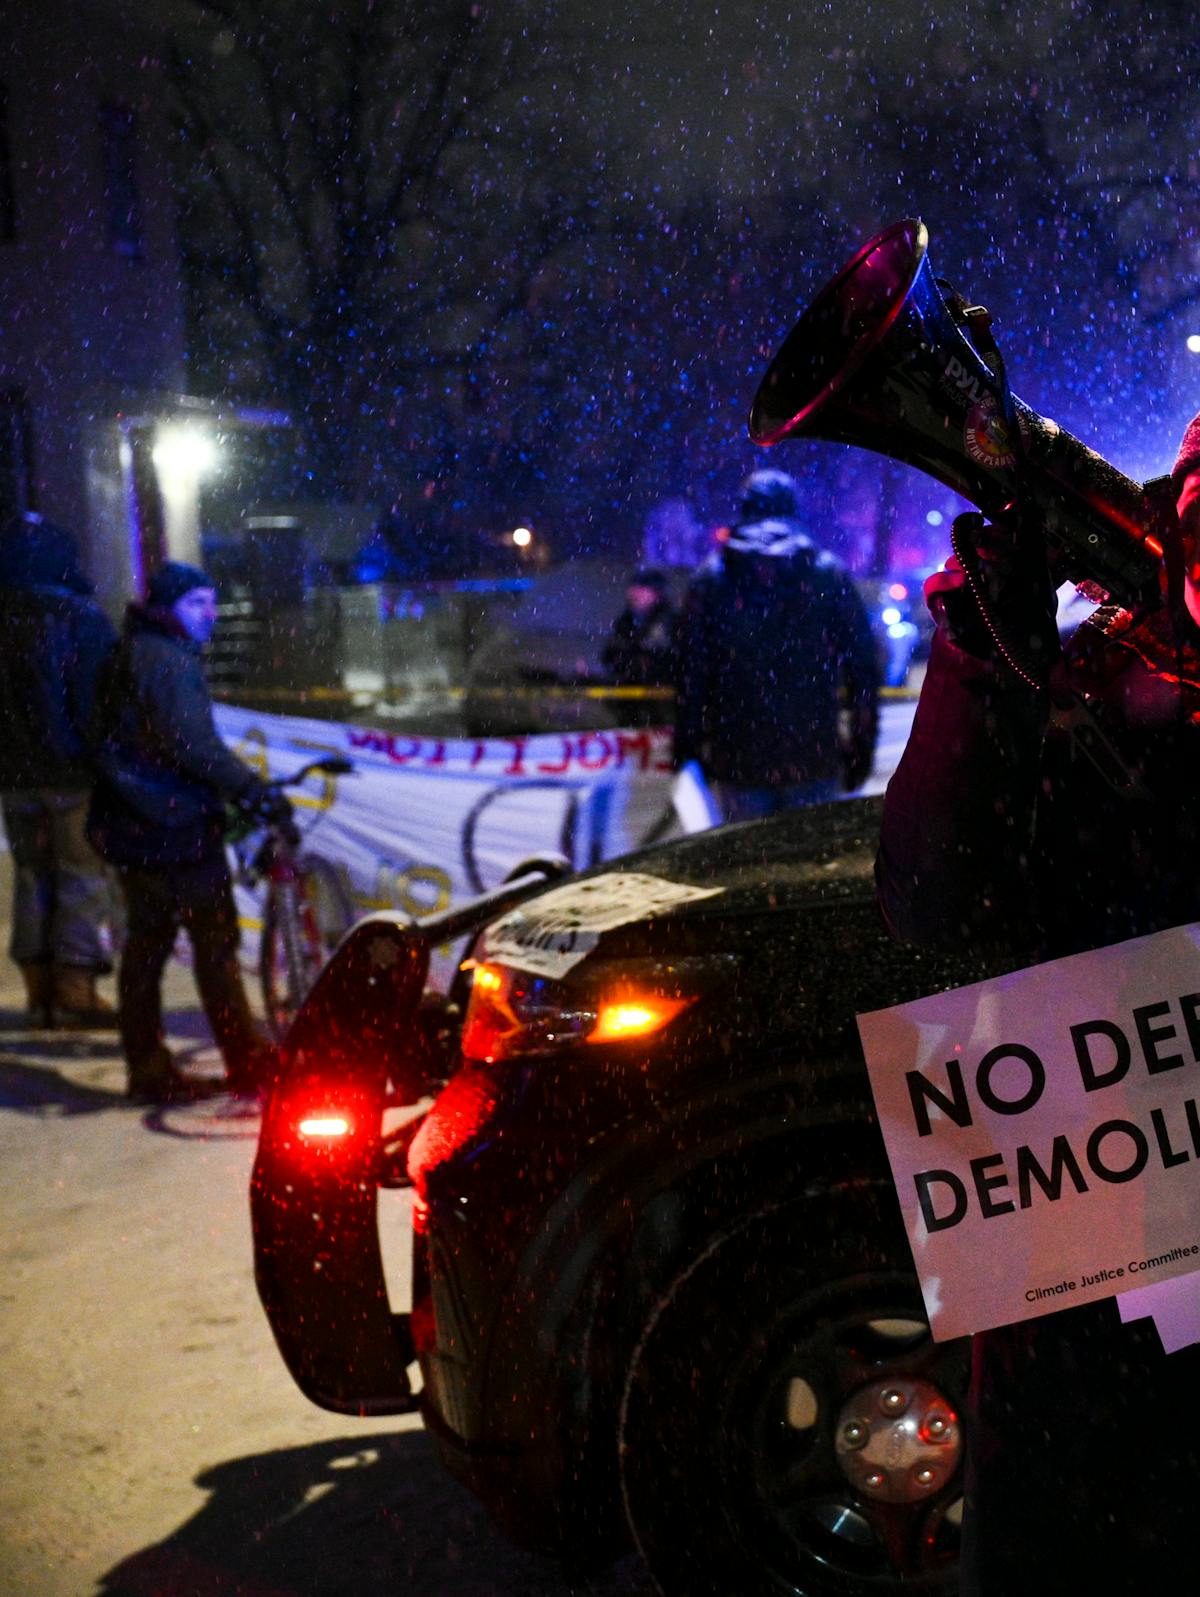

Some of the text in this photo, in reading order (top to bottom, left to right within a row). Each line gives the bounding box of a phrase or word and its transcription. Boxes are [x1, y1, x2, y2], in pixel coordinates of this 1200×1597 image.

[966, 428, 976, 444] NOT
[970, 444, 984, 460] THE
[905, 1043, 1046, 1137] NO
[1025, 1278, 1076, 1303] Climate
[1080, 1265, 1125, 1288] Justice
